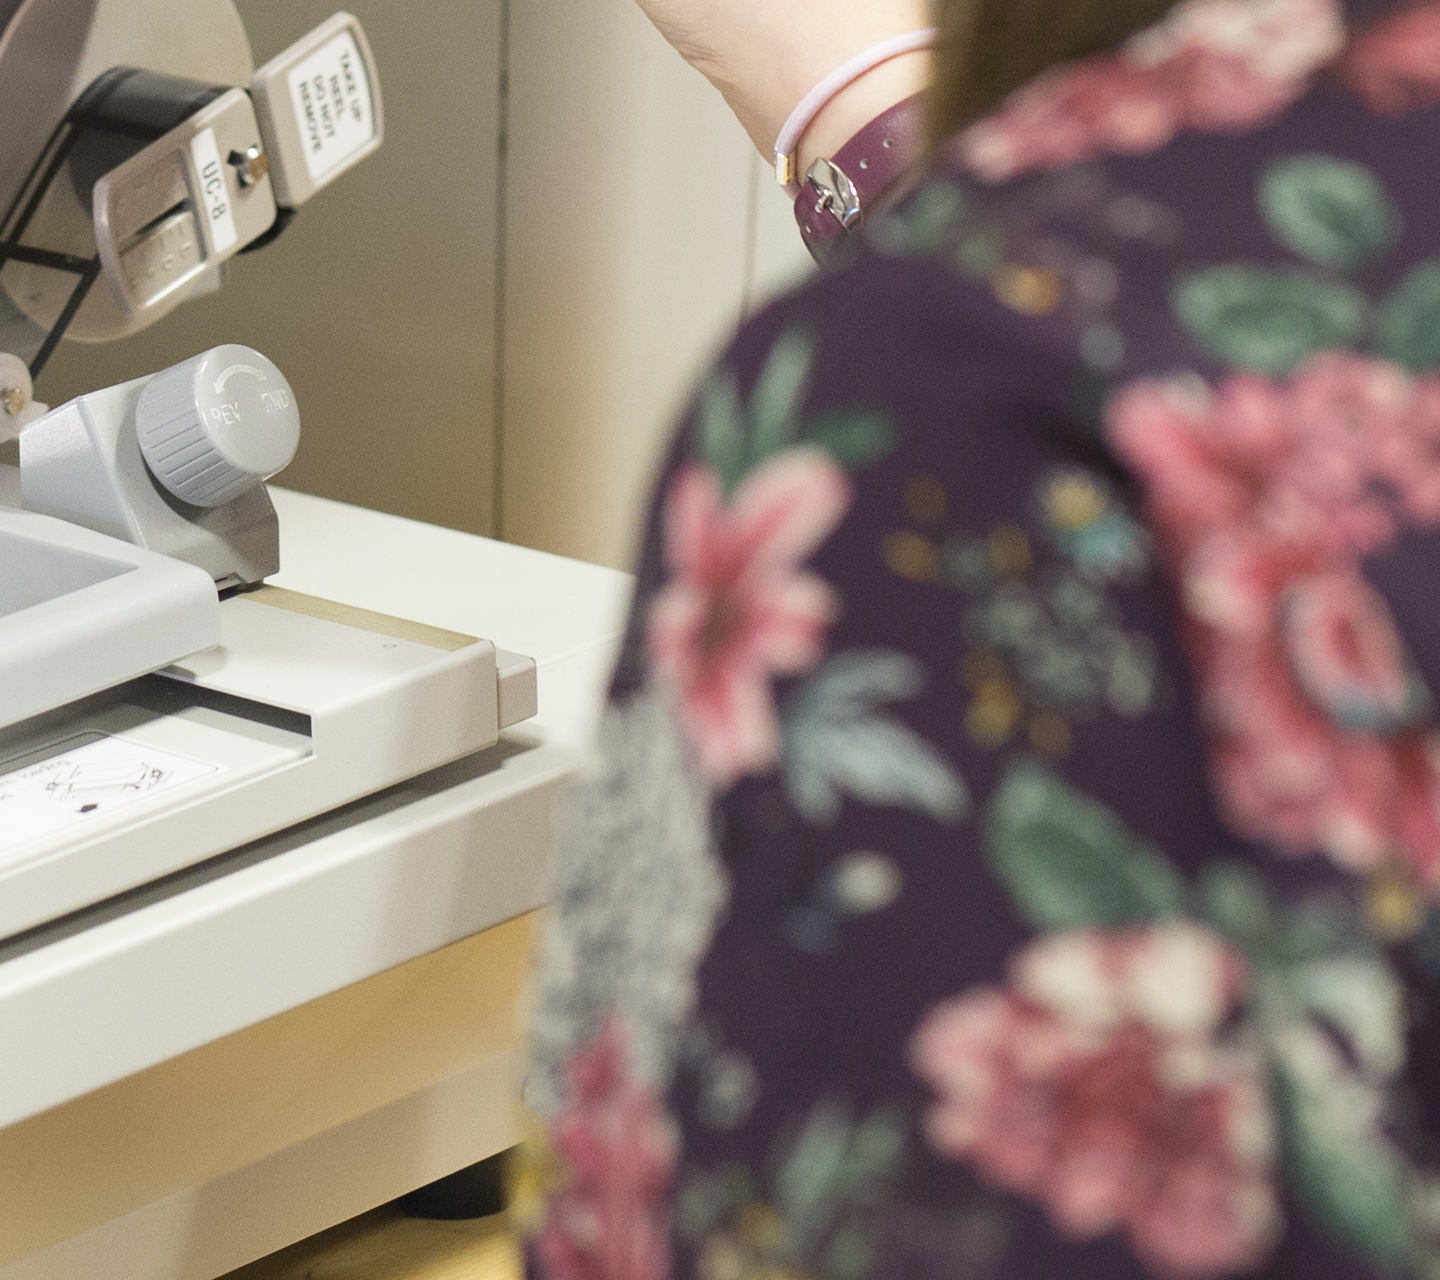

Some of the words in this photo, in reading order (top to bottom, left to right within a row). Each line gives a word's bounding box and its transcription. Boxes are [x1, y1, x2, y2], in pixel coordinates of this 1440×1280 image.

[299, 80, 323, 154] REMOVE
[312, 74, 326, 101] DO
[320, 103, 336, 138] NOT
[329, 74, 344, 121] REEL
[340, 50, 357, 96] TAKE
[350, 98, 363, 122] UP
[201, 159, 227, 221] UC-8
